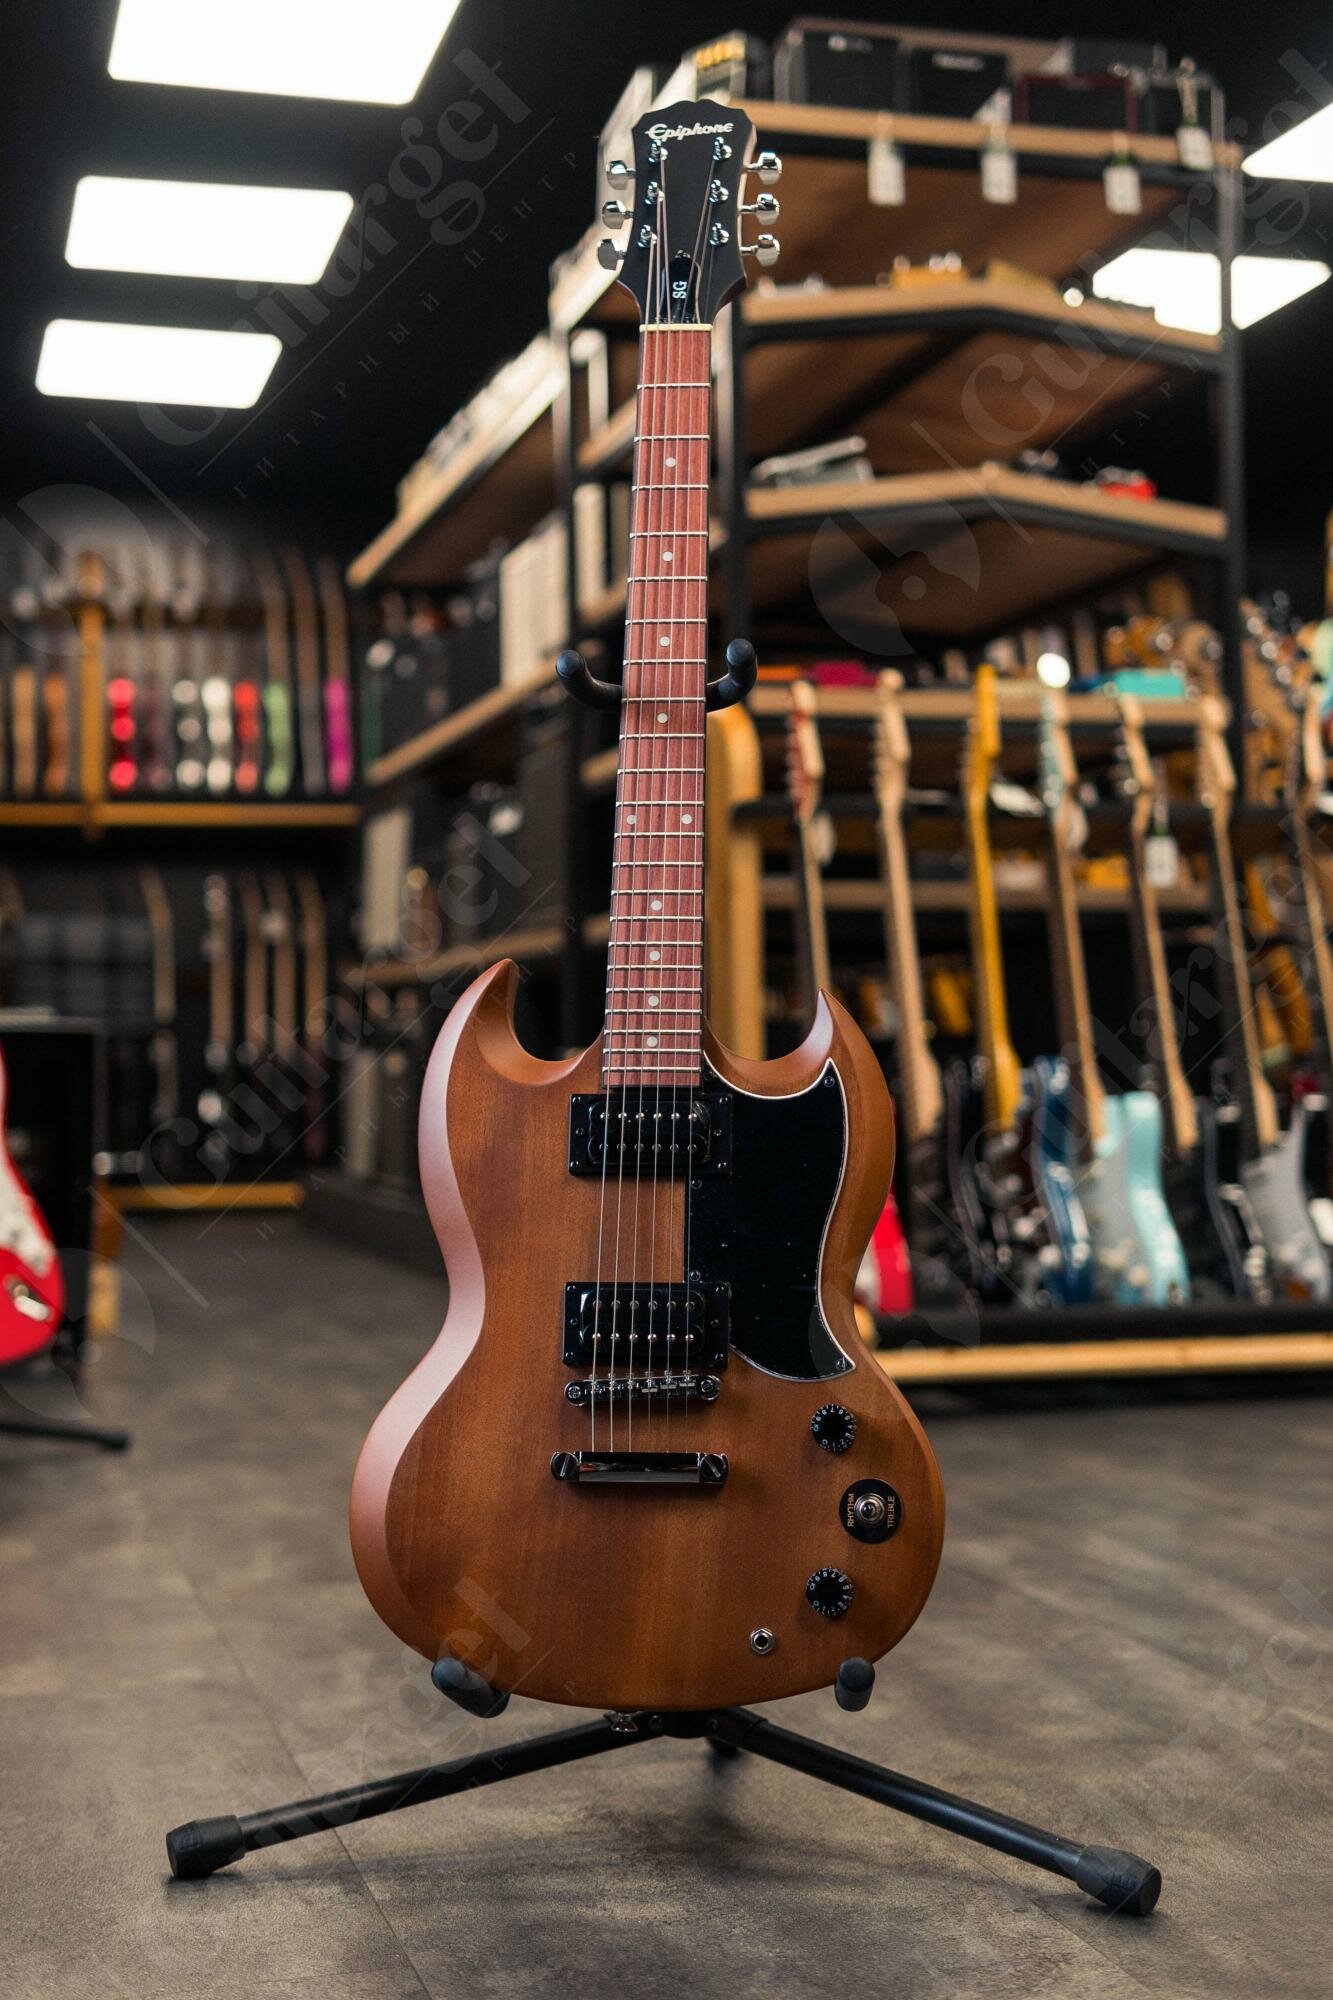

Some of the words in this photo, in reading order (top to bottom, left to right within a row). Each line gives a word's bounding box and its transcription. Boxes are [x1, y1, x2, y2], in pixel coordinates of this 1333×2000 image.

[645, 122, 734, 142] Epiphone
[672, 281, 688, 299] SG
[847, 1493, 855, 1527] RHYTHM
[887, 1495, 895, 1529] TREBLE
